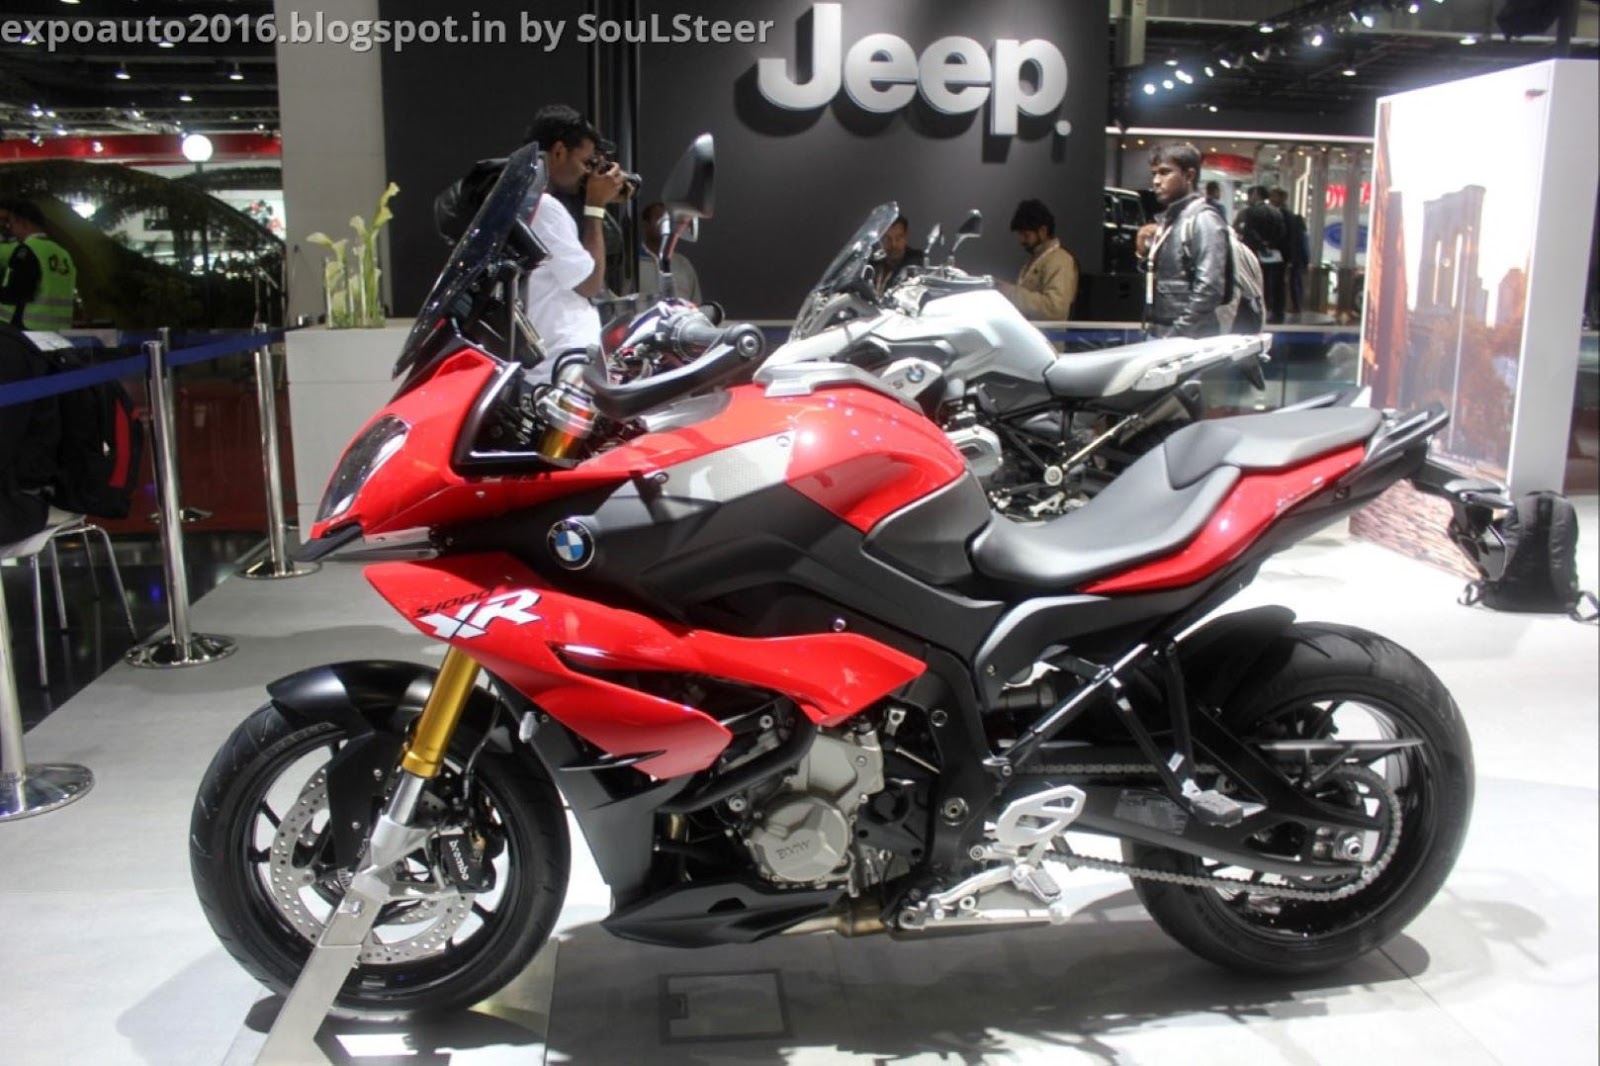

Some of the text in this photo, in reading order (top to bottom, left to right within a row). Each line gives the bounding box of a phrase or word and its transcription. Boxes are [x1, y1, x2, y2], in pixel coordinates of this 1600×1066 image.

[414, 588, 542, 640] XR
[448, 839, 469, 880] brembo
[775, 839, 811, 860] BMW
